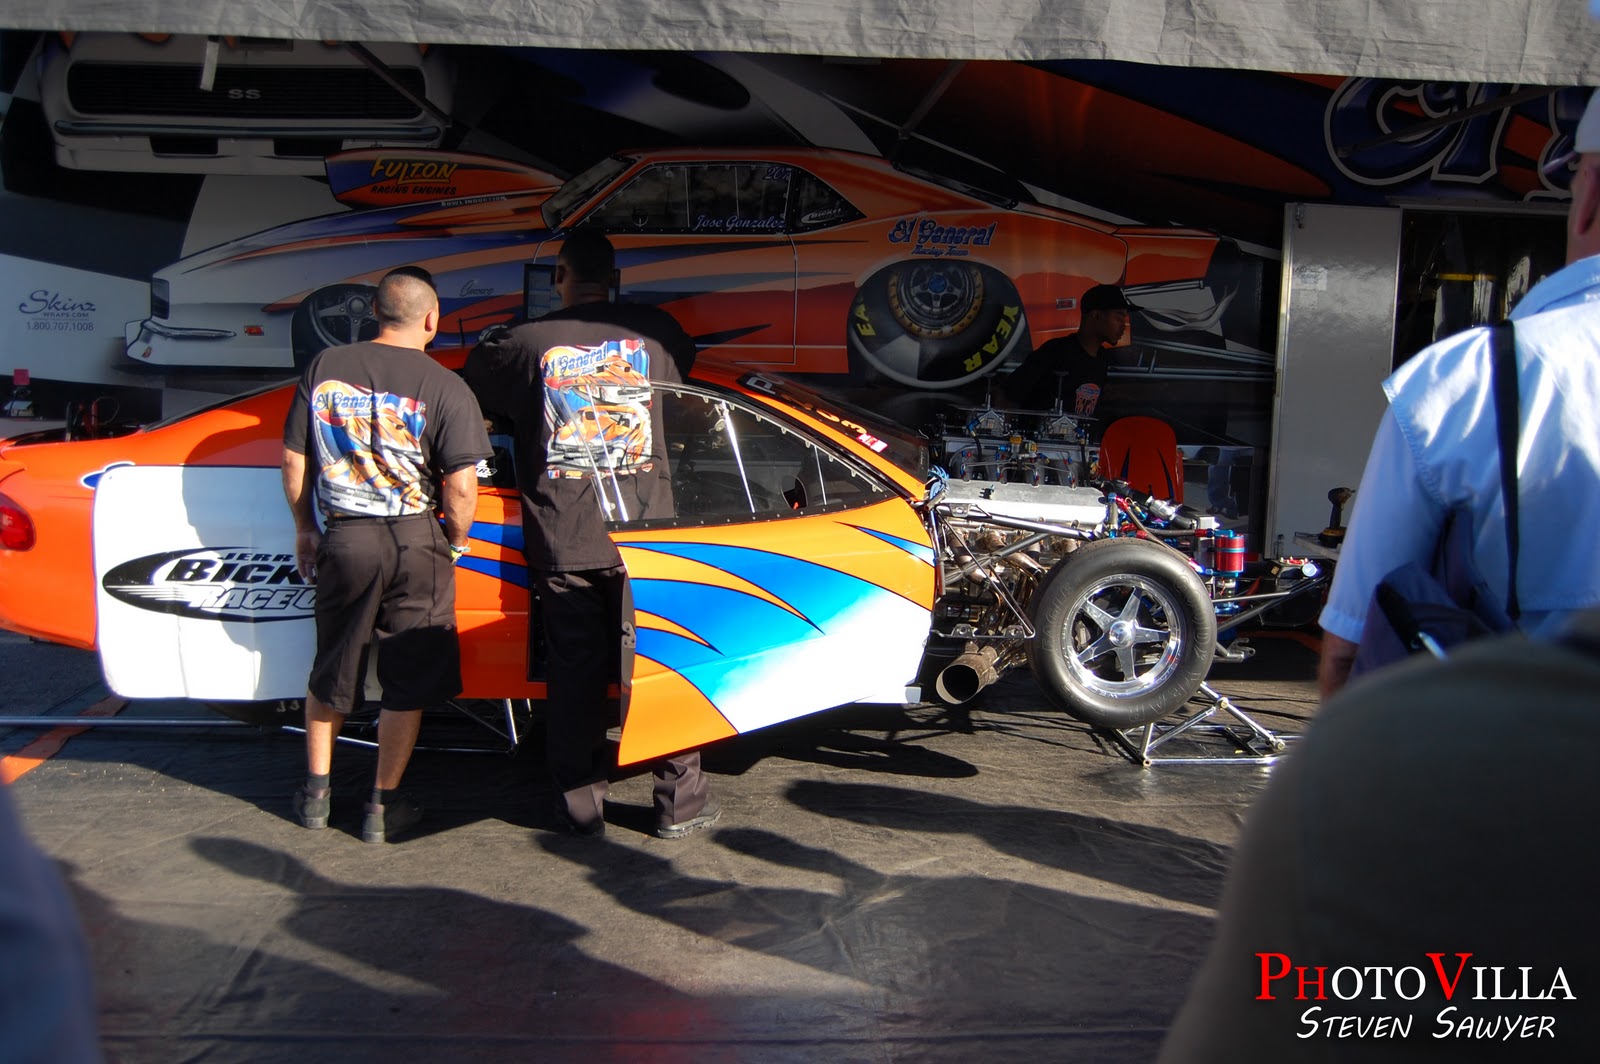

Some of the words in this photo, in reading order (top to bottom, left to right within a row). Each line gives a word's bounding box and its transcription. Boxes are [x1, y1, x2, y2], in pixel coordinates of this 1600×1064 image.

[228, 89, 262, 99] SS
[371, 156, 458, 184] FULTON
[370, 186, 409, 194] RACING
[411, 187, 457, 195] ENGINES
[692, 215, 723, 231] Jose
[888, 218, 917, 243] El
[19, 289, 96, 314] Skinz
[963, 305, 1019, 373] YEAR
[217, 553, 296, 562] JERR
[165, 558, 308, 586] BICK
